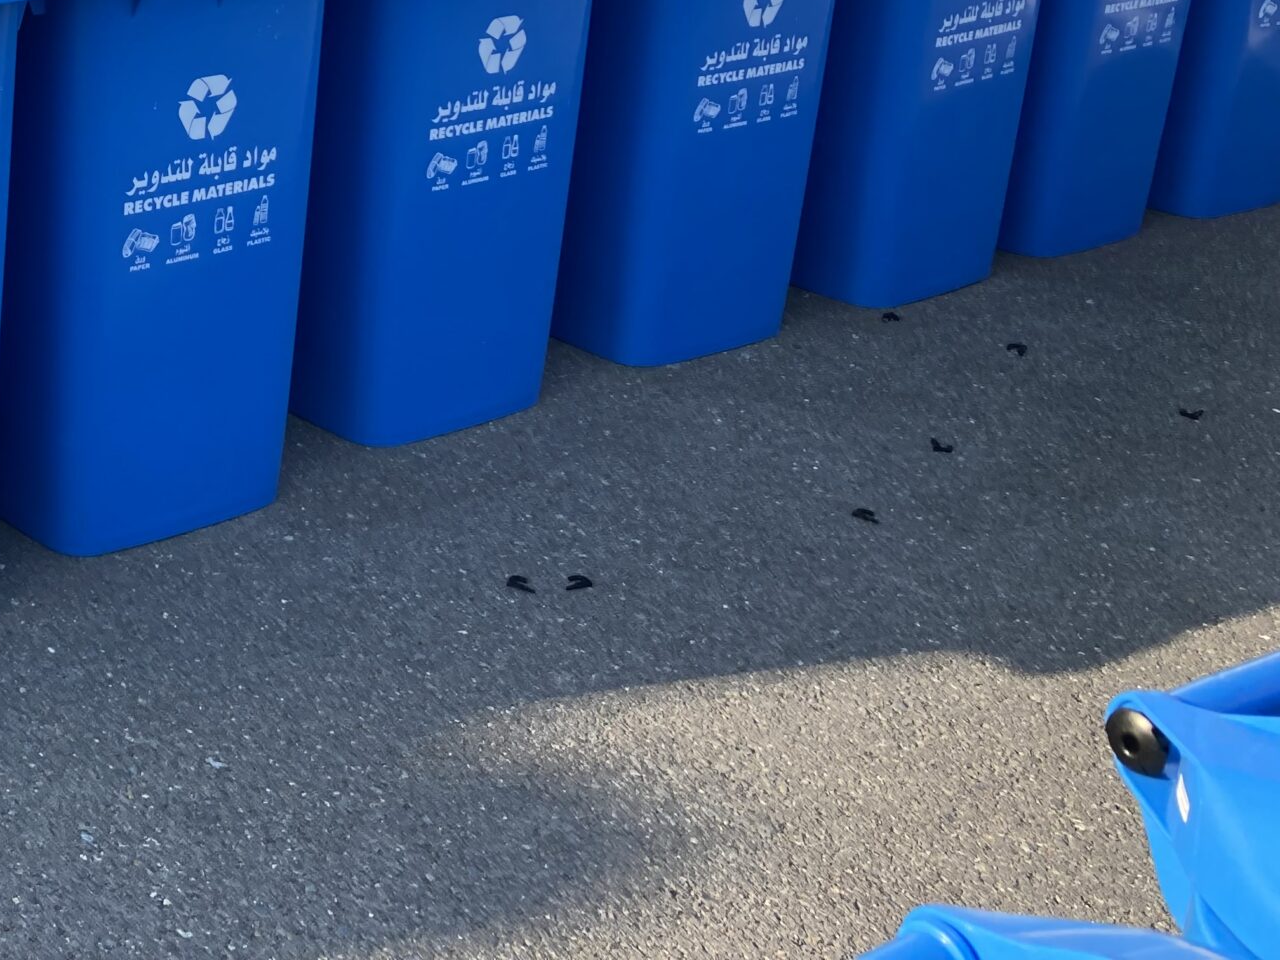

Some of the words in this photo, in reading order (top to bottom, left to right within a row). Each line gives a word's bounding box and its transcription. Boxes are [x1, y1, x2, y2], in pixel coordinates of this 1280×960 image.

[938, 4, 980, 33] للتدوير
[1105, 0, 1138, 14] RECYCLE
[752, 33, 781, 61] قابلة
[783, 34, 808, 55] مواد
[935, 30, 974, 48] RECYCLE
[974, 19, 1022, 40] MATERIALS
[700, 41, 750, 71] للتدوير
[697, 69, 745, 87] RECYCLE
[746, 58, 805, 79] MATERIALS
[491, 80, 525, 111] قابلة
[527, 80, 556, 103] مواد
[431, 90, 489, 124] للتدوير
[429, 119, 483, 141] RECYCLE
[485, 105, 554, 131] MATERIALS
[198, 145, 237, 180] قابلة
[242, 145, 277, 171] مواد
[125, 157, 194, 196] للتدوير
[123, 190, 189, 216] RECYCLE
[192, 173, 276, 203] MATERIALS
[212, 245, 233, 255] GLASS
[129, 263, 150, 273] PAPER
